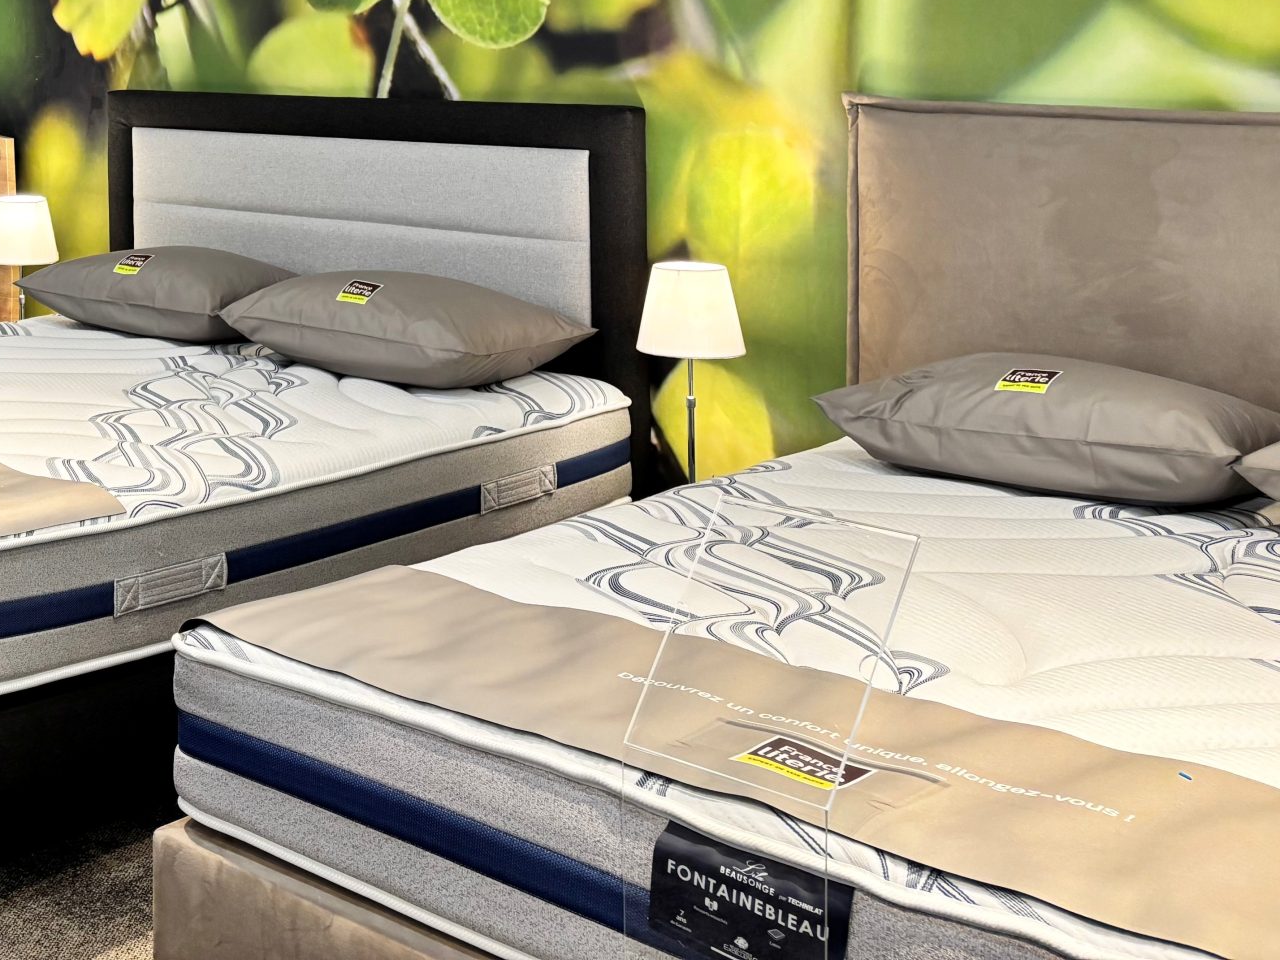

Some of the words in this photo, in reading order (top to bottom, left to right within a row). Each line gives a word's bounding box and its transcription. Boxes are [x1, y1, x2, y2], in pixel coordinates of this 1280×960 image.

[617, 672, 724, 703] Découvrez
[726, 702, 755, 715] un
[758, 712, 841, 741] confort
[935, 762, 1121, 817] allongez-vous
[778, 745, 846, 775] France
[667, 858, 830, 942] FONTAINEBLEAU
[720, 865, 775, 896] BEAUSONGE
[787, 896, 824, 916] TECHNILAT
